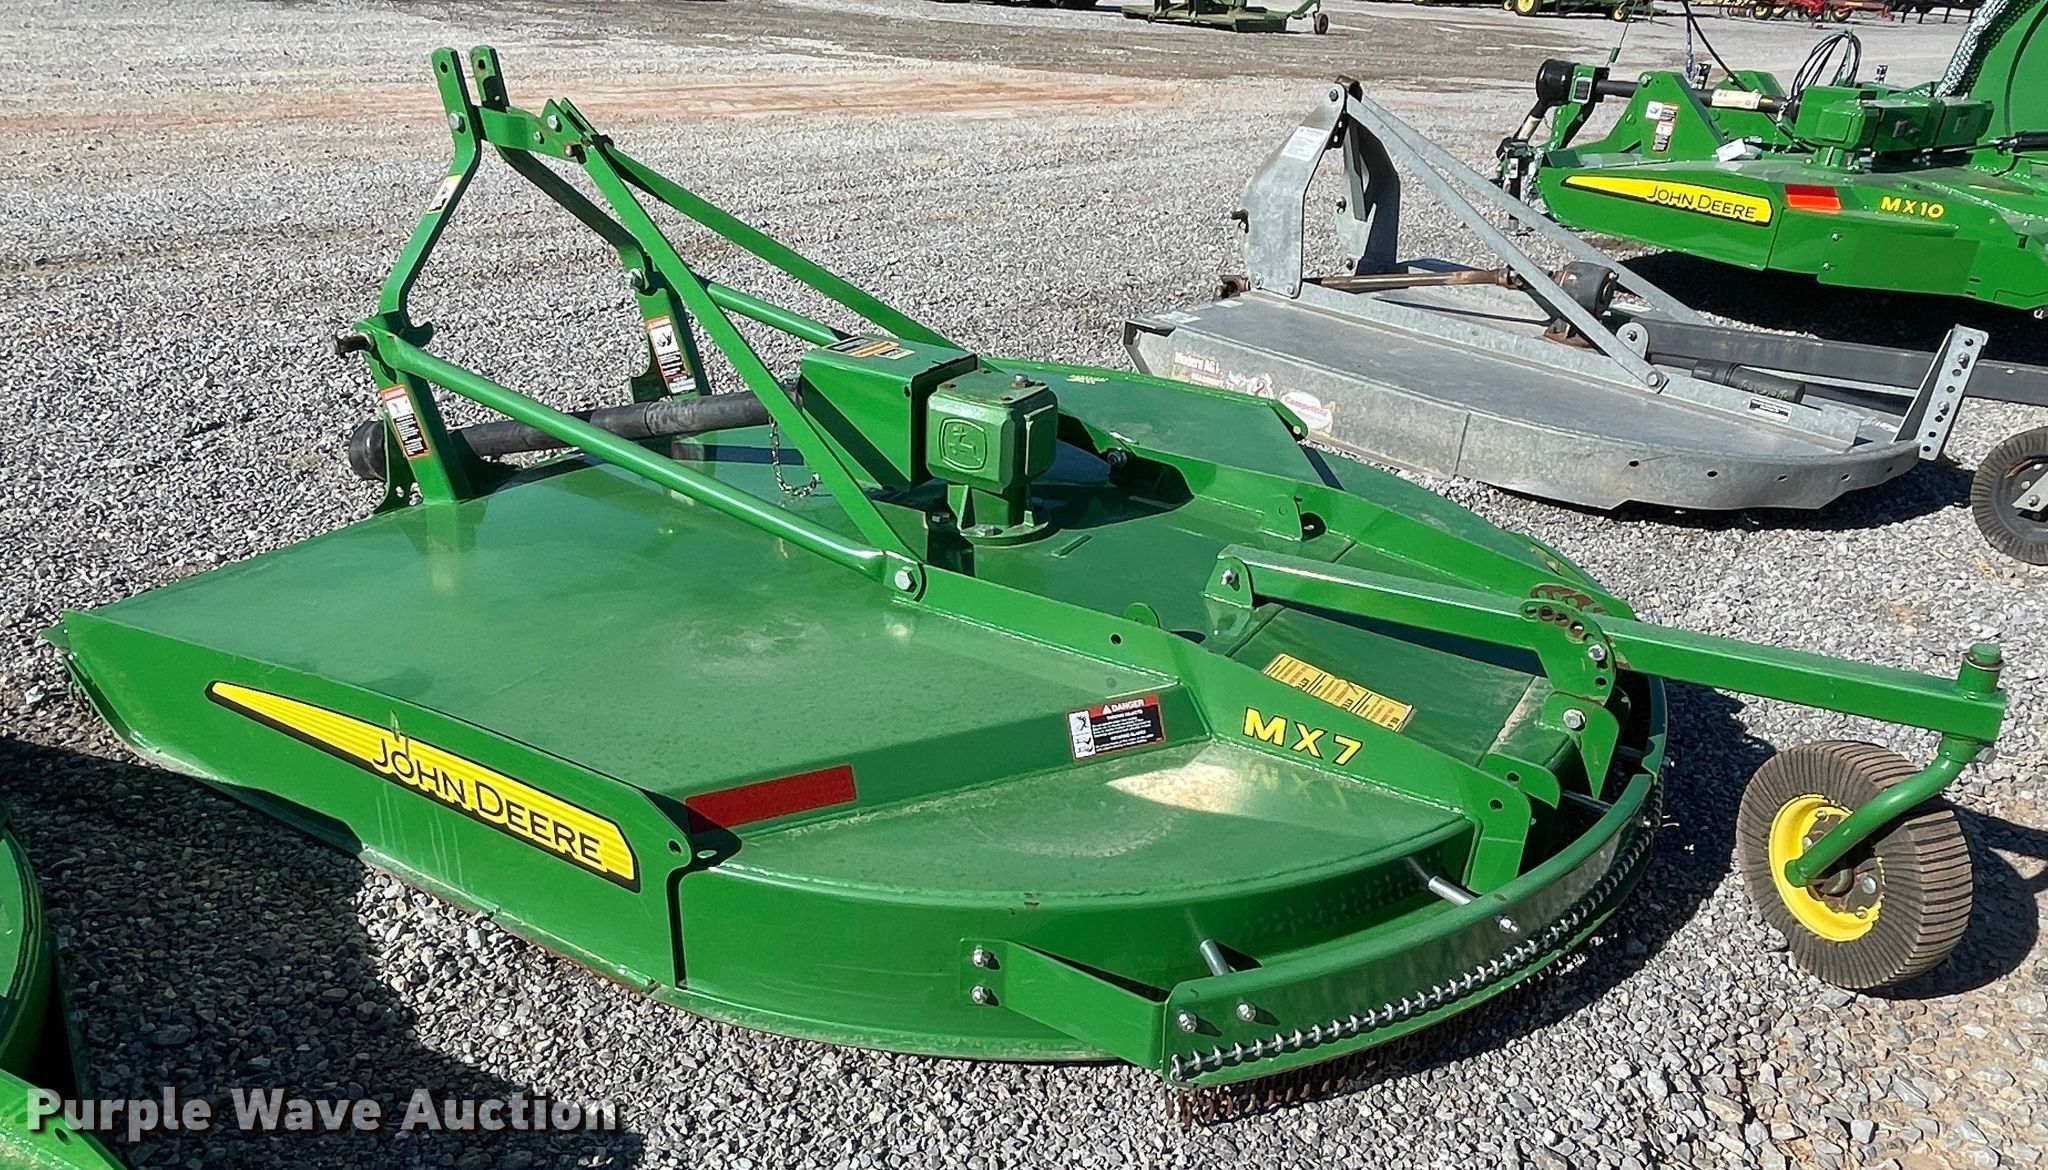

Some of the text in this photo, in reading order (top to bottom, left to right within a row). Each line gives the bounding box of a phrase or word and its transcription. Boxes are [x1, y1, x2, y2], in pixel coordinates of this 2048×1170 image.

[1647, 185, 1757, 219] JOHN DEERE
[1880, 196, 1944, 218] MX10
[1111, 699, 1145, 712] DANGER
[373, 738, 603, 866] JOHN DEERE
